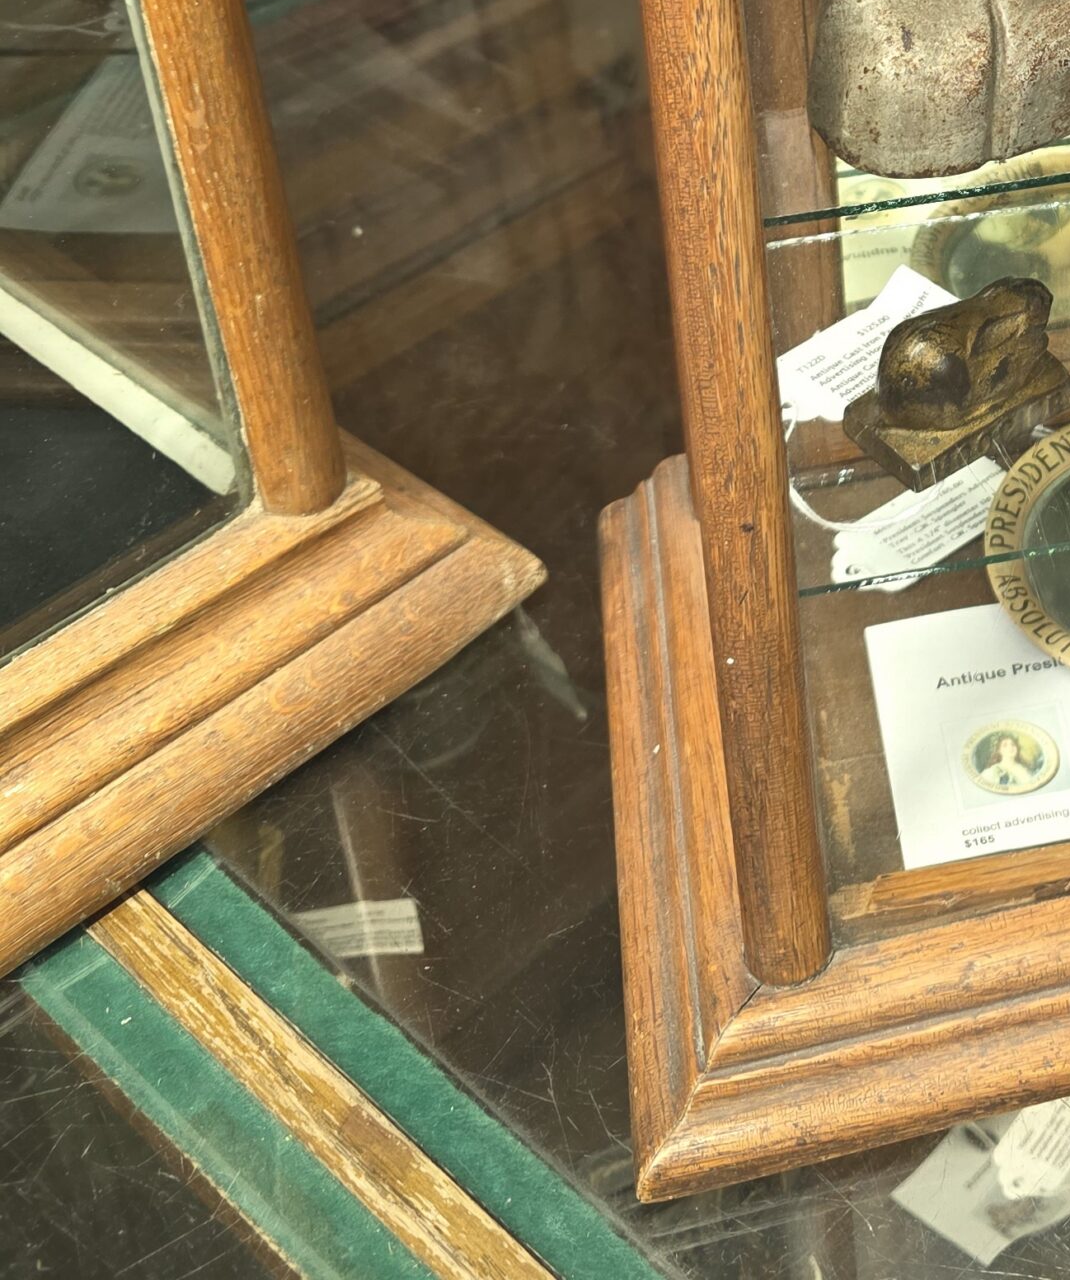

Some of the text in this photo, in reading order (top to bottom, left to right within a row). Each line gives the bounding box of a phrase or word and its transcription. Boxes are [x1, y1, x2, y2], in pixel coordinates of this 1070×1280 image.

[936, 668, 1008, 691] Antique
[1003, 804, 1070, 829] advertising
[963, 834, 996, 849] $165
